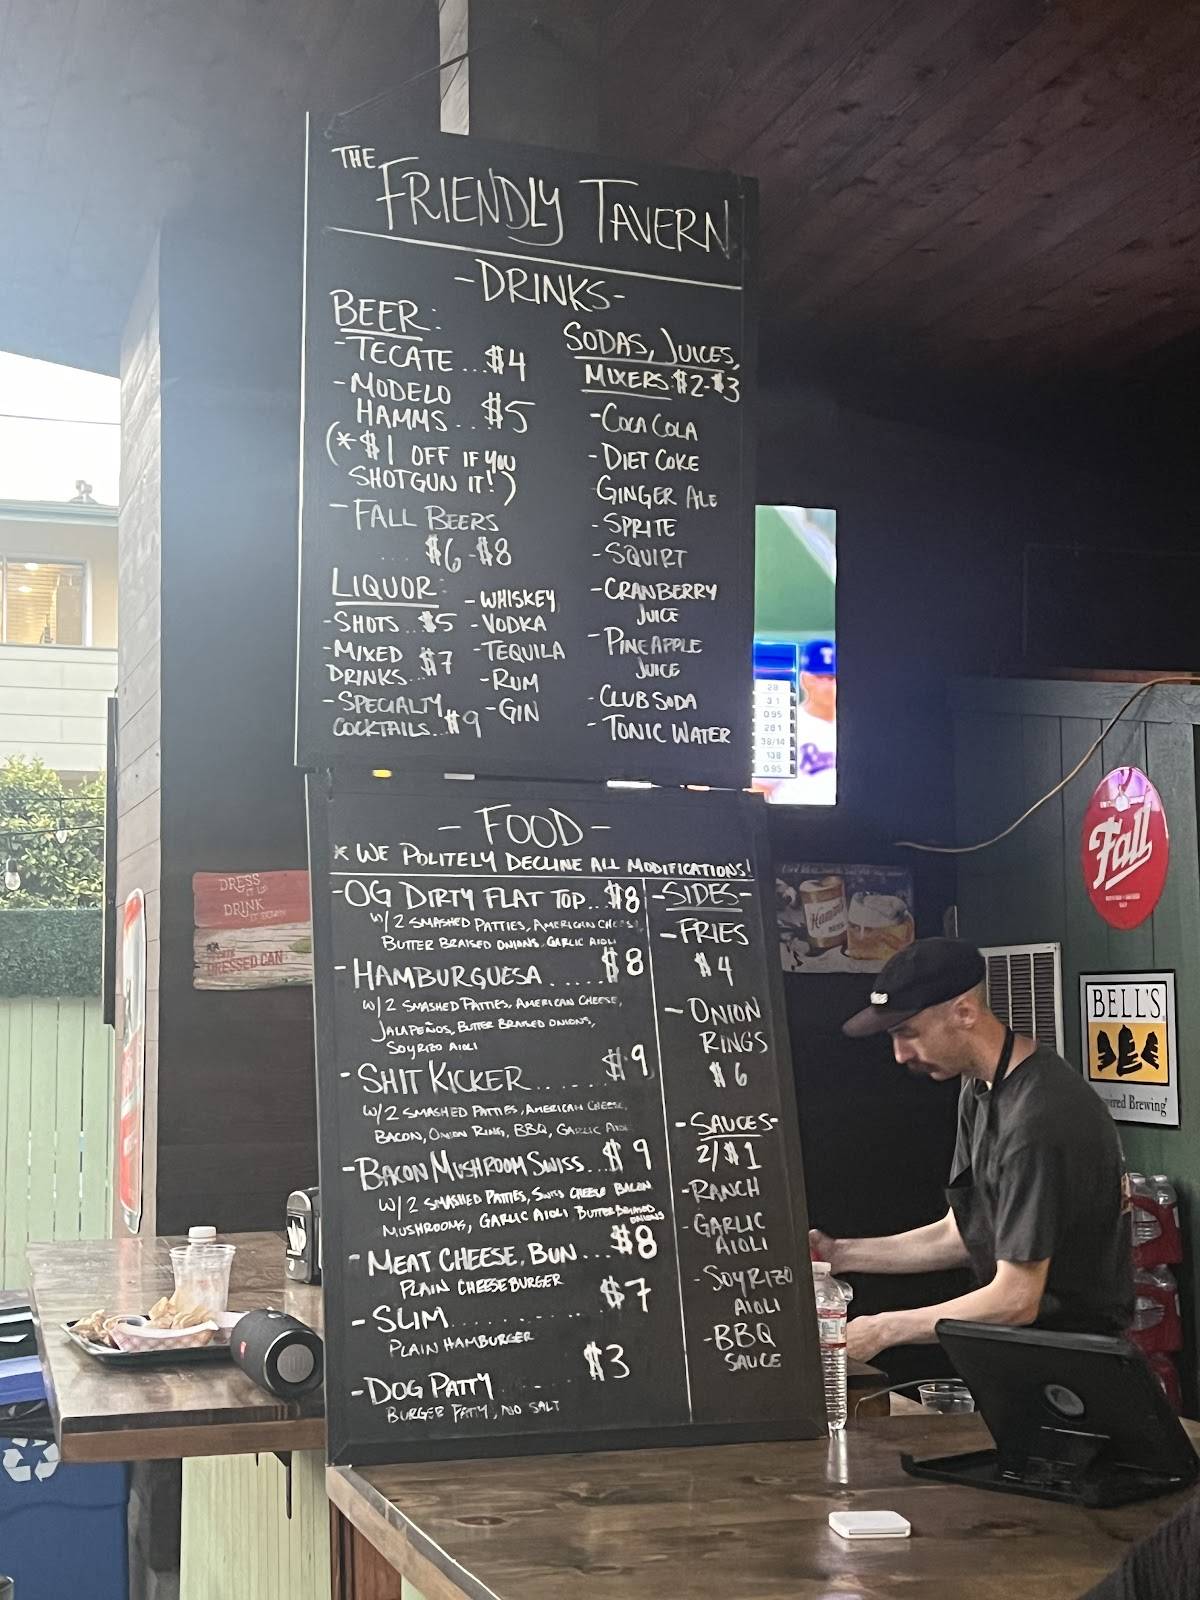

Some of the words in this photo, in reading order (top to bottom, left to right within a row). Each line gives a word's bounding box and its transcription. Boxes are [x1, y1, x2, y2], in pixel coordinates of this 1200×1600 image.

[332, 145, 376, 169] THE
[376, 157, 563, 246] FRIENDLY
[579, 179, 730, 259] TAVERN
[563, 321, 655, 362] SODAS,
[660, 328, 740, 371] JUICES,
[485, 345, 526, 382] $4
[357, 398, 448, 432] HAMMS
[481, 391, 536, 434] $5
[651, 412, 698, 441] COLA
[412, 445, 450, 465] OFF
[463, 451, 479, 467] IF
[485, 450, 516, 474] YOU
[655, 445, 699, 472] COKE
[348, 465, 457, 493] SHOTGUN
[686, 485, 718, 510] ALE
[424, 505, 500, 532] BEERS
[418, 610, 457, 633] $5
[636, 606, 679, 626] JUICE
[325, 663, 407, 686] DRINKS
[419, 647, 453, 676] $7
[635, 662, 680, 679] JUICE
[653, 691, 698, 711] SODA
[332, 717, 431, 737] COCKTAILS
[671, 721, 731, 746] WATER
[1089, 801, 1152, 890] Fall
[398, 842, 497, 873] POLITELY
[505, 852, 583, 873] DECLINE
[590, 857, 620, 872] ALL
[627, 857, 753, 878] MODIFICATIONS!
[218, 873, 260, 893] DRESS
[224, 899, 265, 917] DRINK
[398, 880, 475, 911] DIRTY
[482, 887, 545, 909] FLAT
[550, 889, 586, 910] TOP
[604, 880, 640, 913] $8
[408, 917, 470, 929] SMASHED
[533, 918, 596, 932] AMERICAN
[381, 934, 434, 951] BUTTER
[439, 937, 491, 949] BRAISED
[546, 936, 584, 948] GARLIC
[601, 946, 644, 983] $8
[402, 1000, 460, 1012] SMASHED
[516, 998, 575, 1009] AMERICAN
[1093, 988, 1160, 1019] BELL'S
[457, 1021, 494, 1033] BUTTER
[448, 1042, 478, 1051] AIOLI
[699, 1032, 768, 1054] RINGS
[428, 1060, 532, 1095] KICKER
[402, 1106, 468, 1119] SMASHED
[428, 1128, 468, 1140] ONION
[430, 1150, 528, 1183] MUSHROOM
[527, 1150, 585, 1176] SWISS
[424, 1194, 482, 1210] SMASHED
[479, 1210, 528, 1228] GARLIC
[533, 1208, 569, 1221] AIOLI
[528, 1242, 577, 1265] BUN
[609, 1223, 658, 1260] $8
[716, 1236, 768, 1254] AIOLI
[399, 1279, 450, 1300] PLAIN
[600, 1275, 651, 1312] $7
[735, 1298, 781, 1316] AIOLI
[389, 1339, 438, 1358] PLAIN
[444, 1331, 534, 1352] HAMBURGER
[428, 1371, 494, 1400] PATTY
[584, 1341, 630, 1381] $3
[725, 1353, 781, 1372] SAUCE
[501, 1404, 522, 1416] NO
[529, 1400, 560, 1414] SALT
